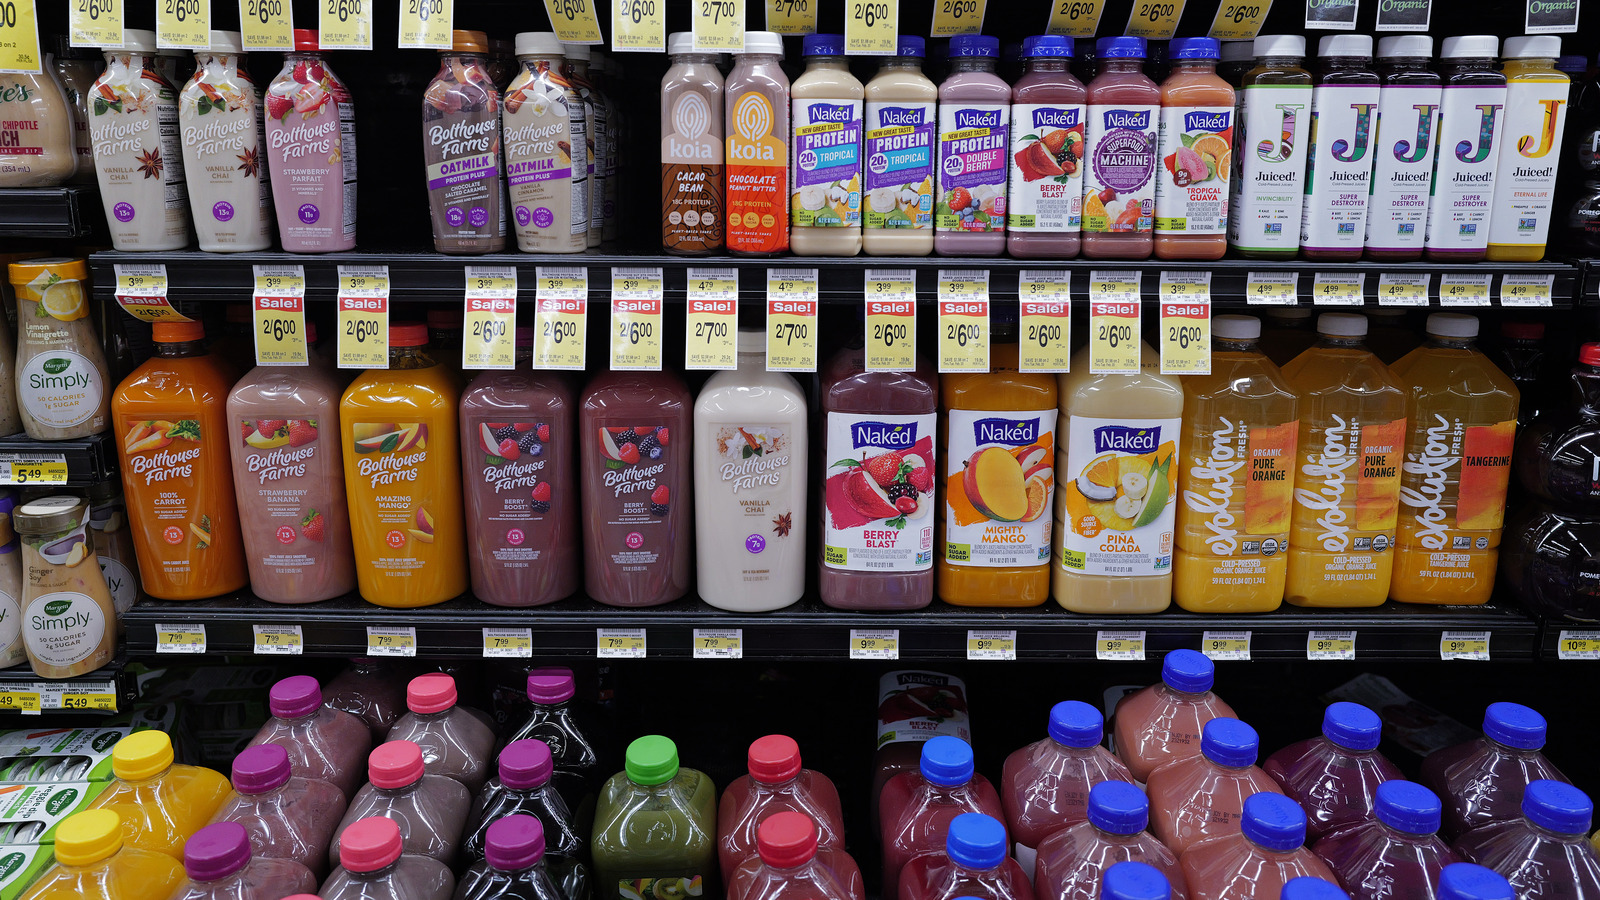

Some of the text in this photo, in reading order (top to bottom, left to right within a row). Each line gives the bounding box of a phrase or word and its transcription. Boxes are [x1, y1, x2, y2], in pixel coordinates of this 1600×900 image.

[1382, 0, 1428, 11] Organic
[1530, 0, 1576, 14] Organic
[3, 121, 38, 130] CHIPOTLE
[184, 119, 251, 146] Bolthouse
[270, 121, 336, 148] Bolthouse
[429, 119, 496, 146] Bolthouse
[504, 123, 563, 145] Bolthouse
[806, 130, 857, 148] PROTEIN
[877, 134, 928, 151] PROTEIN
[951, 134, 1003, 153] PROTEIN
[197, 138, 243, 160] Farms
[282, 141, 330, 162] Farms
[442, 138, 489, 159] Farms
[509, 143, 555, 160] Farms
[670, 140, 712, 159] koia
[730, 140, 774, 160] koia
[1107, 142, 1144, 153] SUPERFOOD
[820, 150, 854, 162] TROPICAL
[966, 153, 996, 163] DOUBLE
[1101, 155, 1148, 165] MACHINE
[440, 157, 489, 175] OATMILK
[507, 159, 554, 175] OATMILK
[966, 162, 991, 171] BERRY
[1513, 166, 1553, 176] Juiced!
[445, 171, 486, 184] PROTEIN PLUS
[677, 172, 705, 182] CACAO
[730, 175, 776, 184] CHOCOLATE
[1255, 171, 1296, 181] Juiced!
[1329, 171, 1369, 181] Juiced!
[1391, 171, 1429, 181] Juiced!
[1453, 172, 1492, 182] Juiced!
[445, 186, 487, 198] SALTED CARAMEL
[451, 182, 480, 191] CHOCOLATE
[518, 187, 544, 195] CINNAMON
[679, 183, 703, 192] BEAN
[1040, 184, 1066, 192] BERRY
[260, 298, 297, 308] Sale!
[471, 300, 509, 310] Sale!
[773, 302, 810, 312] Sale!
[872, 303, 909, 313] Sale!
[1026, 304, 1064, 314] Sale!
[26, 322, 49, 330] Lemon
[26, 330, 69, 340] Vinaigrette
[30, 374, 89, 390] Simply
[48, 393, 85, 401] CALORIES
[1365, 446, 1393, 454] ORGANIC
[131, 448, 200, 473] Bolthouse
[246, 448, 314, 472] Bolthouse
[358, 452, 426, 476] Bolthouse
[1253, 460, 1274, 469] PURE
[1365, 456, 1386, 466] PURE
[1466, 456, 1510, 466] TANGERINE
[259, 464, 305, 484] Farms
[483, 461, 544, 482] Bolthouse
[719, 456, 788, 481] Bolthouse
[1364, 467, 1396, 478] ORANGE
[145, 465, 192, 485] Farms
[370, 467, 417, 488] Farms
[603, 464, 664, 486] Bolthouse
[1252, 470, 1286, 481] ORANGE
[495, 474, 536, 493] Farms
[615, 478, 656, 497] Farms
[733, 472, 779, 493] Farms
[1184, 416, 1245, 555] evolution
[1294, 414, 1356, 552] evolution
[1401, 414, 1458, 550] evolution
[863, 531, 900, 540] BERRY
[985, 526, 1023, 535] MIGHTY
[866, 540, 896, 548] BLAST
[982, 534, 1026, 543] MANGO
[1107, 534, 1134, 544] PIÑA
[1100, 544, 1141, 552] COLADA
[1333, 556, 1371, 564] COLD-PRESSED
[29, 566, 54, 576] Ginger
[32, 614, 89, 630] Simply
[49, 632, 86, 641] CALORIES
